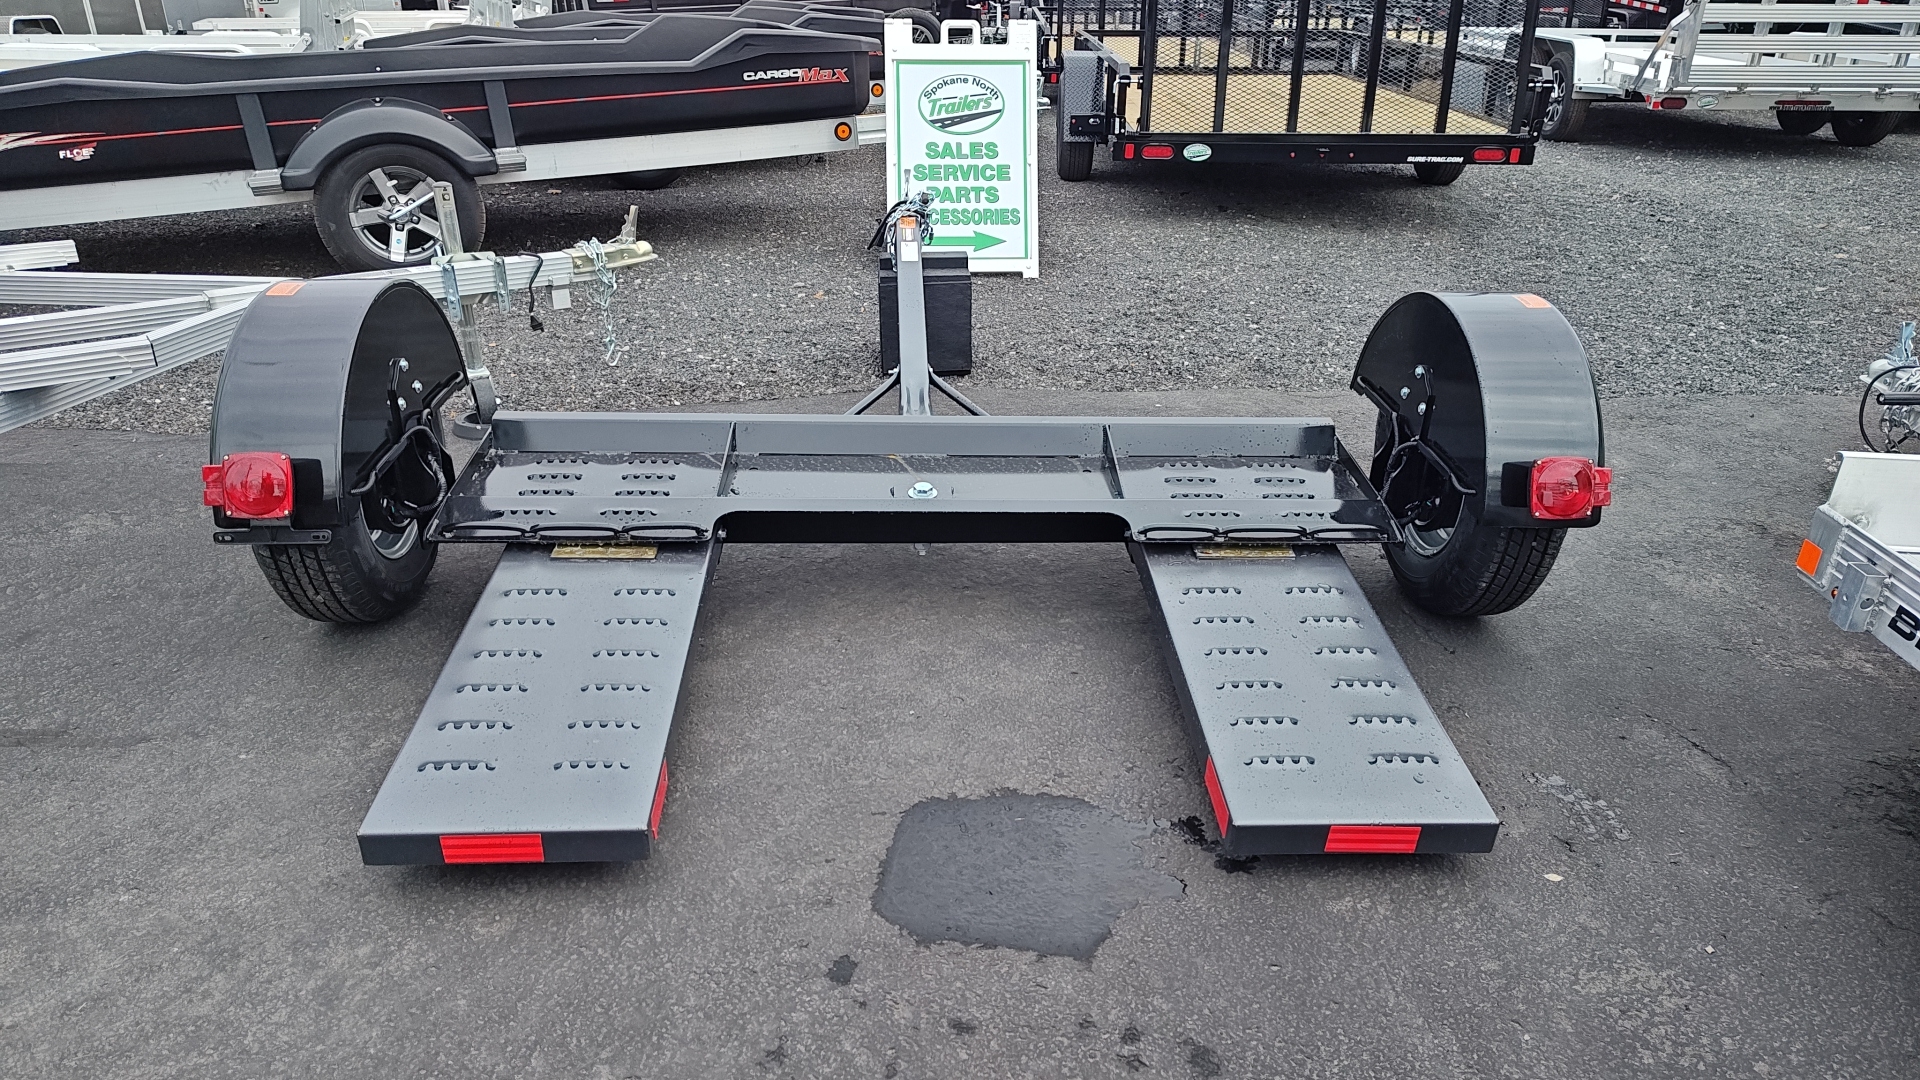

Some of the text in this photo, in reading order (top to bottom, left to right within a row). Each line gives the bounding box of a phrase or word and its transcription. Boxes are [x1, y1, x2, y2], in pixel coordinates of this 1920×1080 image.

[923, 77, 1000, 100] Spokane North
[928, 95, 993, 117] Trailers
[925, 142, 999, 159] SALES
[912, 164, 1011, 181] SERVICE
[928, 208, 1021, 225] CESSORIES
[1887, 604, 1920, 651] B
